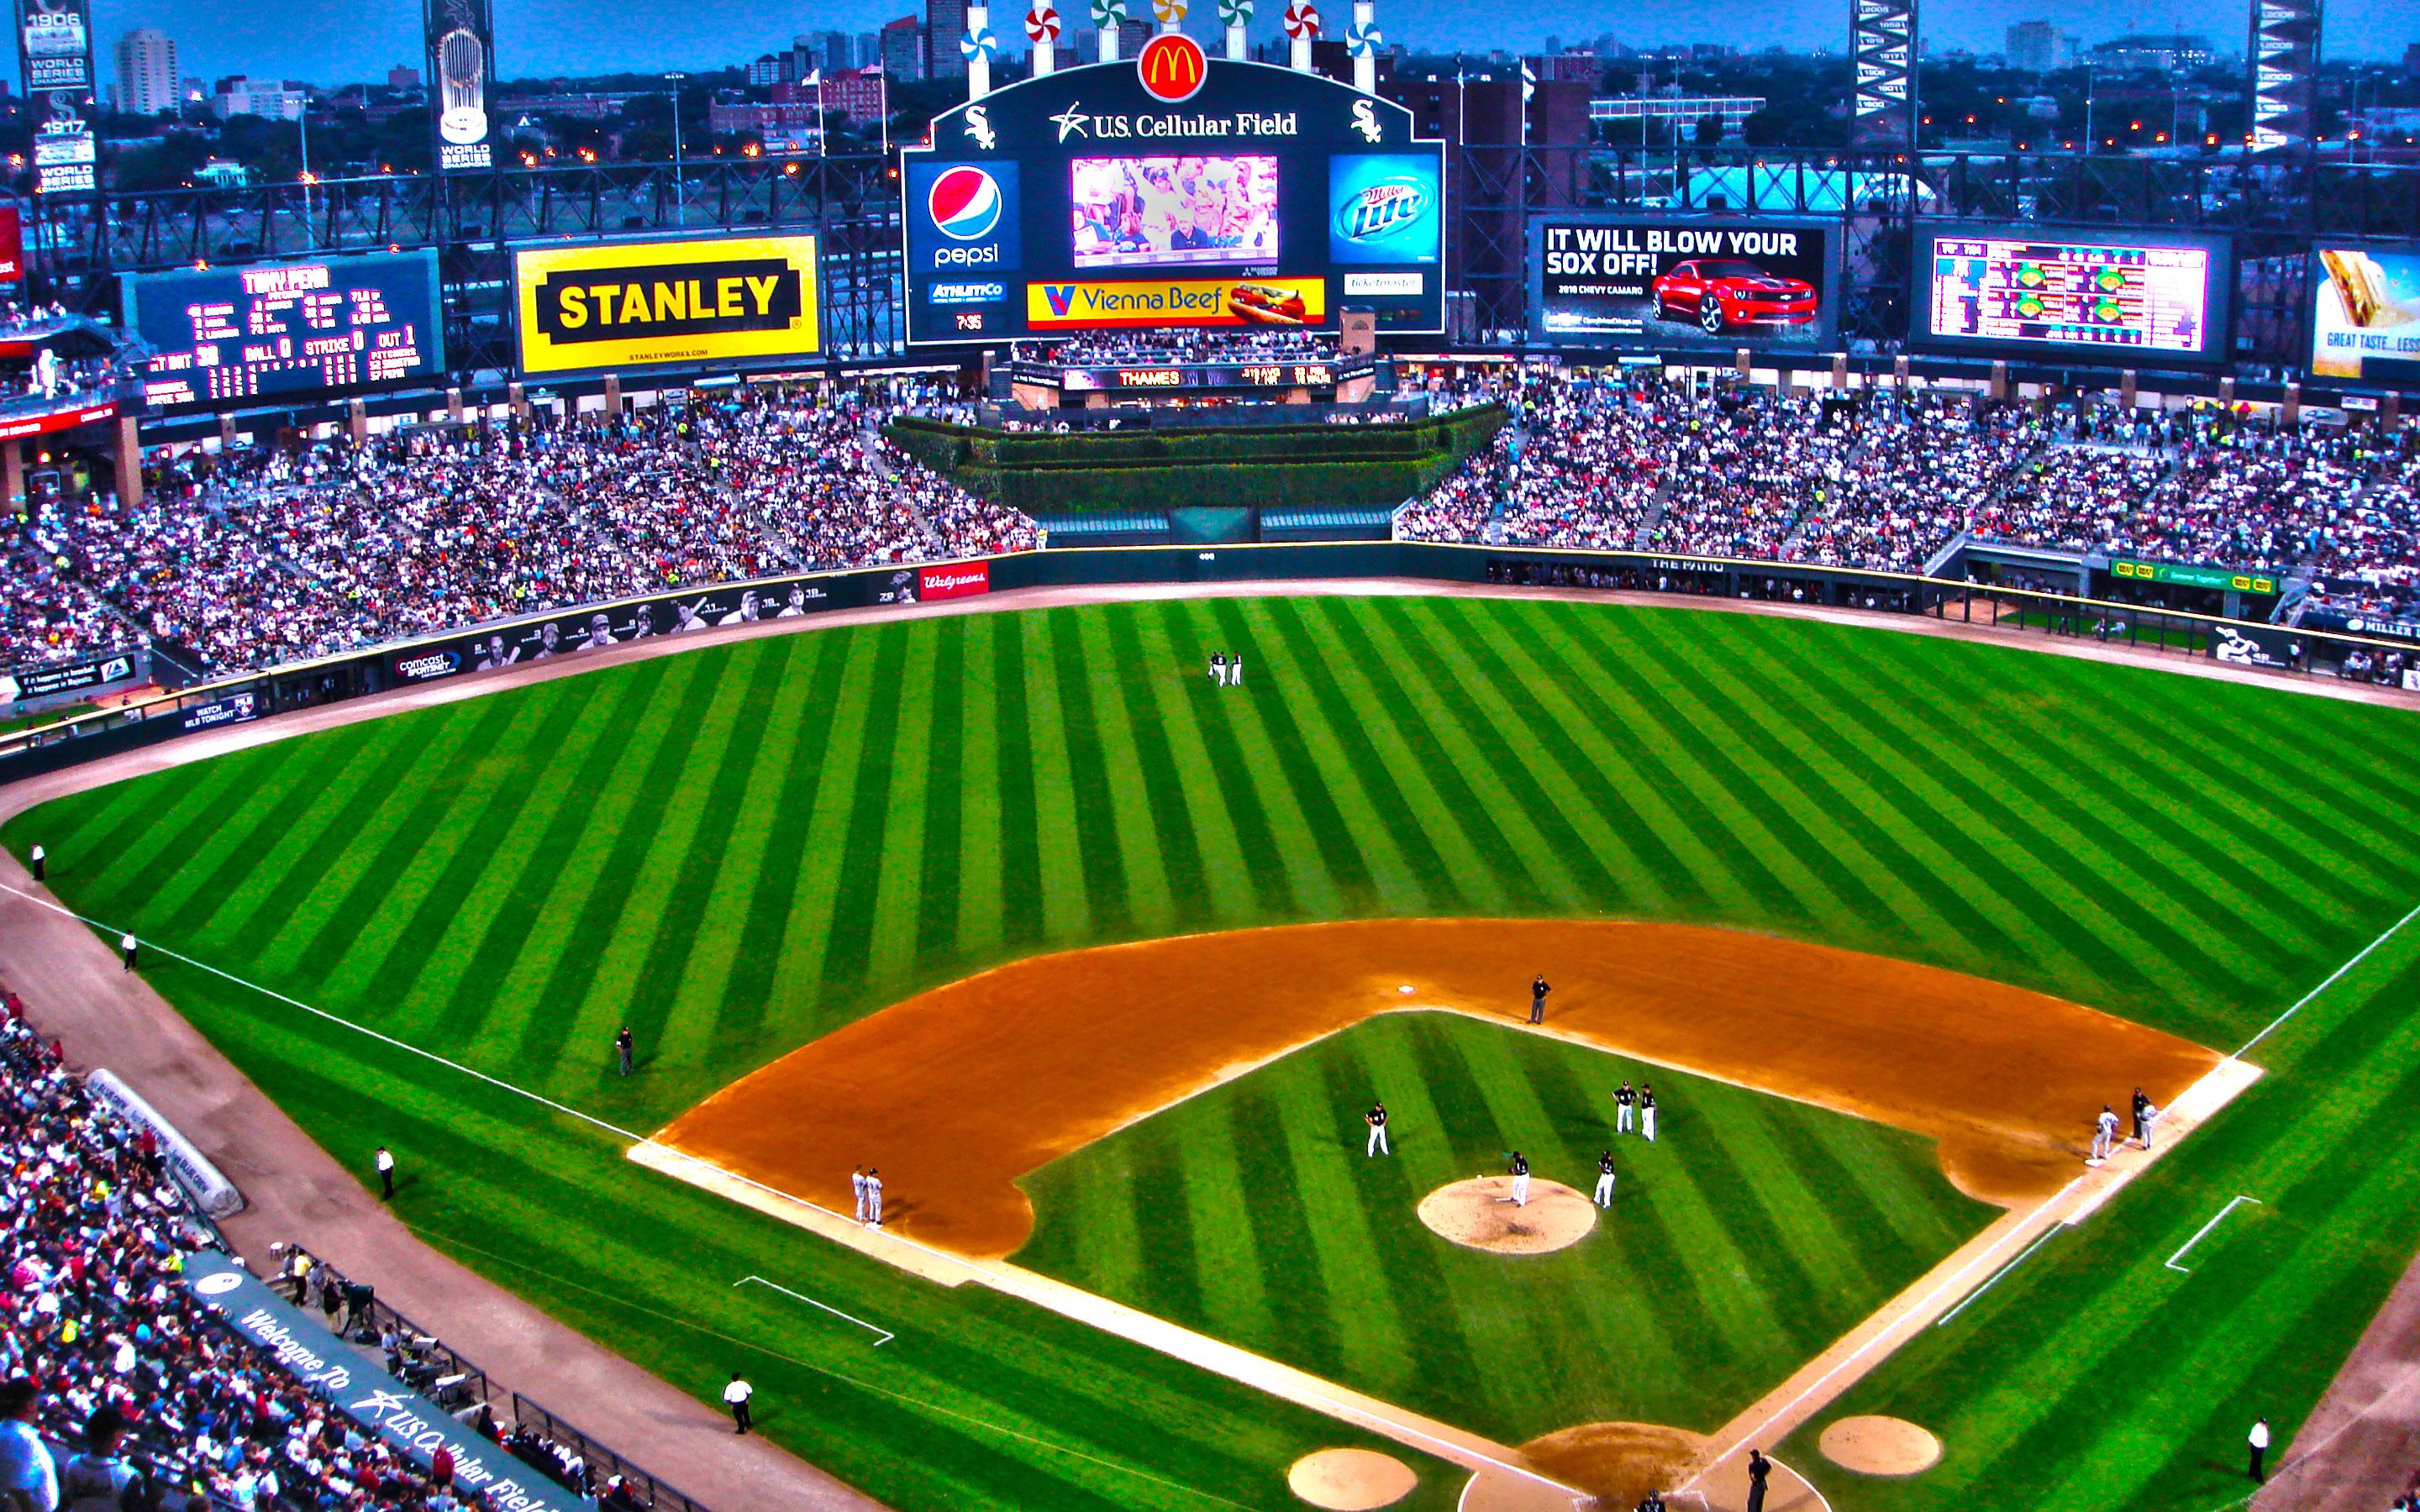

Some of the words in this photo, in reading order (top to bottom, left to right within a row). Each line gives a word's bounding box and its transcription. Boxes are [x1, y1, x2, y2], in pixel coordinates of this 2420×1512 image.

[28, 13, 82, 27] 1906
[32, 58, 84, 69] WORLD
[32, 68, 85, 78] SERIES
[42, 120, 86, 134] 1917
[1094, 116, 1132, 138] U.S.
[1136, 114, 1232, 137] Cellular
[1235, 113, 1298, 136] Field
[441, 144, 490, 155] WORLD
[442, 153, 491, 163] SERIES
[40, 165, 94, 177] WORLD
[41, 175, 95, 186] SERIES
[1366, 186, 1407, 204] Miller
[1352, 194, 1420, 239] Lite
[1547, 228, 1570, 249] IT
[1576, 229, 1641, 251] WILL
[1647, 231, 1723, 254] BLOW
[1728, 232, 1797, 255] YOUR
[935, 244, 998, 268] pepsi
[1547, 252, 1597, 274] SOX
[1603, 254, 1658, 276] OFF!
[1559, 286, 1577, 294] 2010
[1579, 286, 1606, 294] CHEVY
[1607, 286, 1644, 295] CAMARO
[559, 276, 779, 329] STANLEY
[1082, 288, 1164, 310] Vienna
[1170, 287, 1222, 314] Beef
[2328, 332, 2356, 347] GREAT
[149, 355, 166, 372] AT
[168, 354, 192, 370] BAT
[245, 346, 276, 362] BALL
[279, 338, 292, 358] 0
[305, 338, 350, 355] STRIKE
[352, 330, 365, 350] 0
[378, 332, 401, 348] OUT
[405, 325, 415, 345] 1
[371, 348, 417, 360] PITCHERS
[629, 349, 708, 361] STANLEYWORKS.COM
[1120, 370, 1180, 386] THAMES
[1653, 559, 1678, 570] THE
[1683, 561, 1723, 572] PATIO
[924, 573, 985, 590] Walgreens
[704, 603, 716, 612] 11
[2365, 622, 2412, 637] MILLER
[400, 654, 444, 671] comcast
[408, 662, 450, 677] SPORTSNET
[185, 717, 200, 727] MLB
[201, 710, 234, 724] TONIGHT
[197, 705, 222, 717] WATCH
[180, 1159, 197, 1175] BLUE
[241, 1309, 324, 1371] Welcome
[319, 1365, 350, 1389] To
